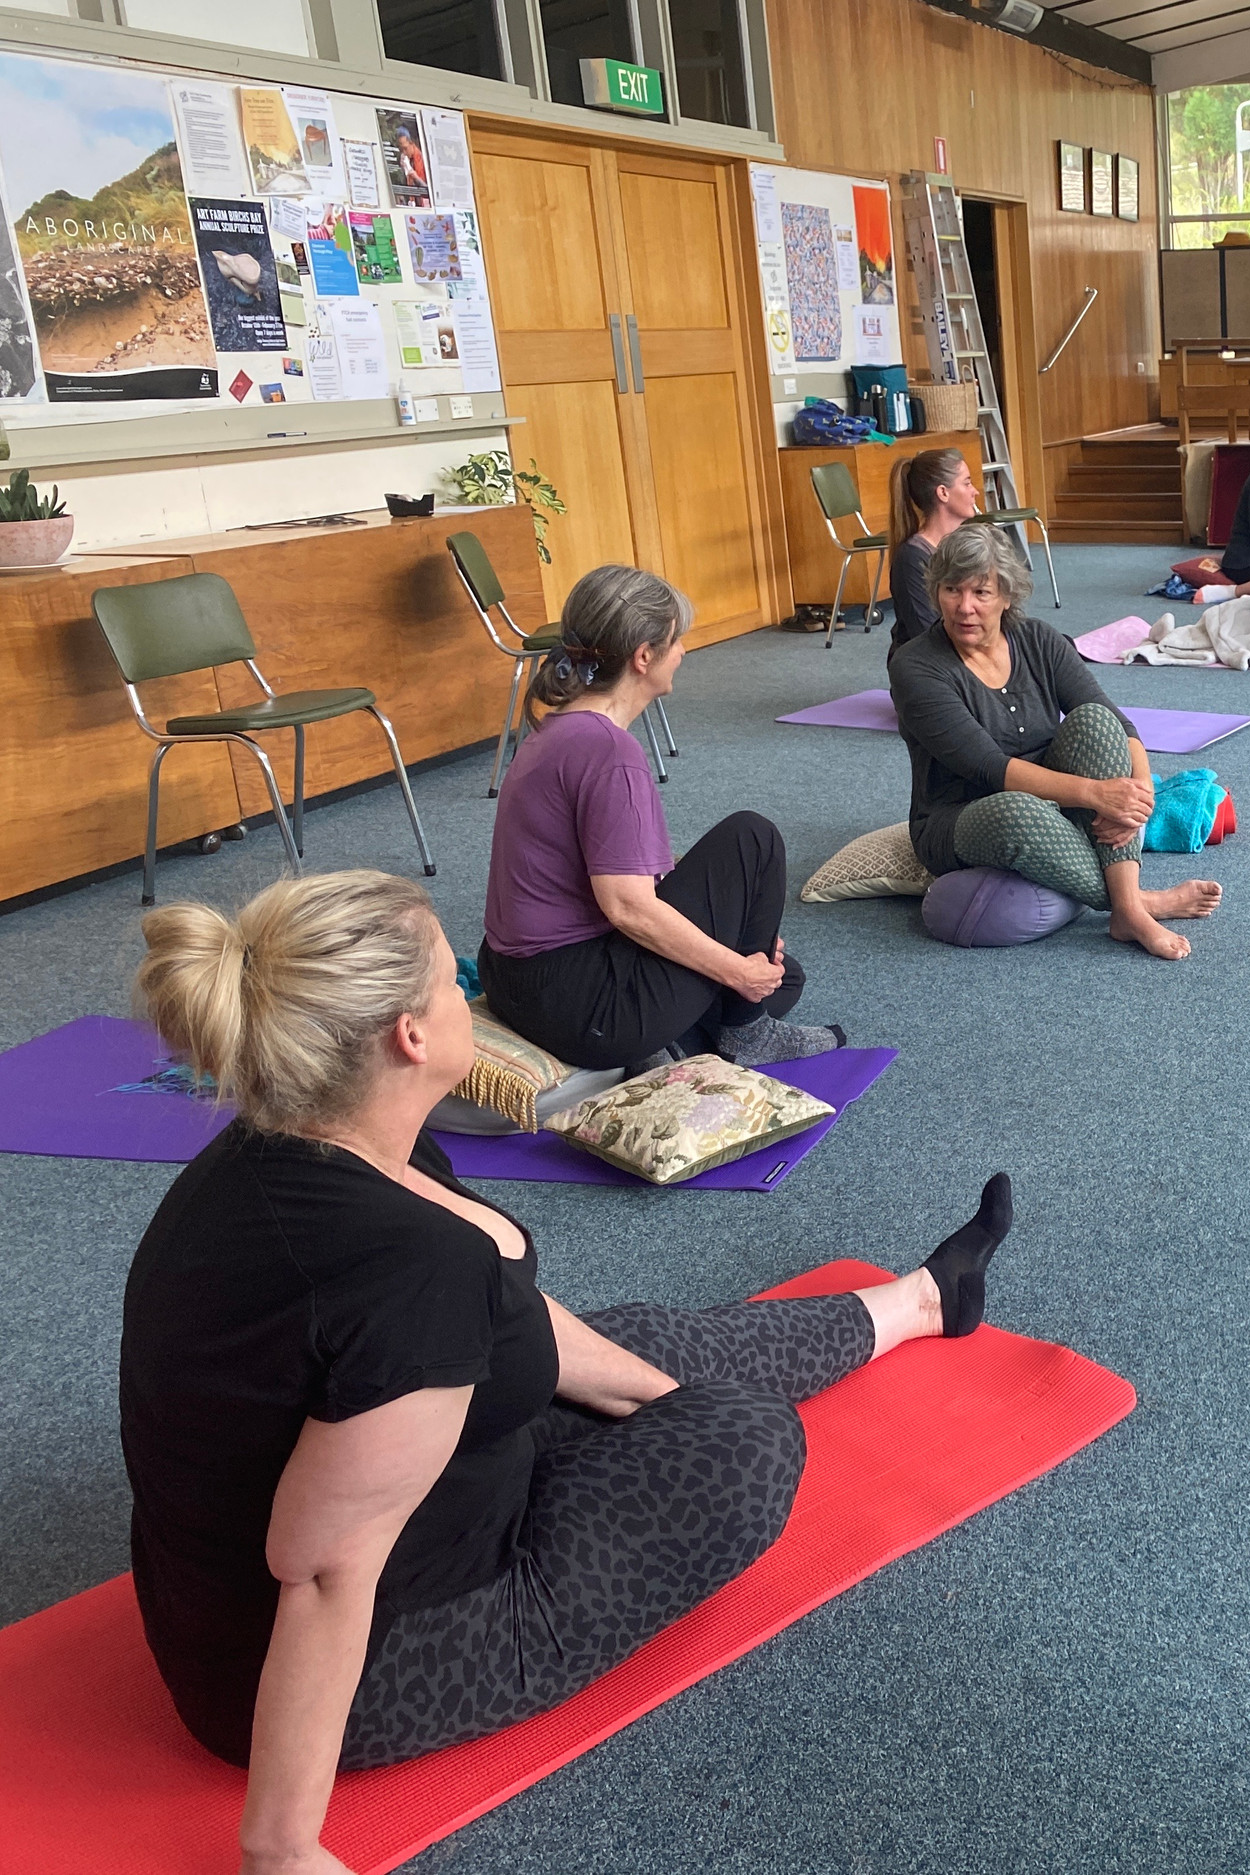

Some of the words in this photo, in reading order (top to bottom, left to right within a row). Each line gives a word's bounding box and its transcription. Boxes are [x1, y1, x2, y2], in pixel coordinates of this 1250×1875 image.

[617, 68, 648, 104] EXIT
[196, 207, 210, 220] ART
[209, 209, 228, 221] FARM
[228, 210, 250, 223] BIRCHS
[250, 212, 262, 224] BAY
[25, 215, 188, 245] ABORIGINAL
[199, 221, 221, 232] ANNUAL
[221, 222, 250, 234] SCULPTURE
[250, 224, 265, 235] PRIZE
[67, 240, 160, 257] LANDSCAPES
[934, 302, 950, 351] BAILEY
